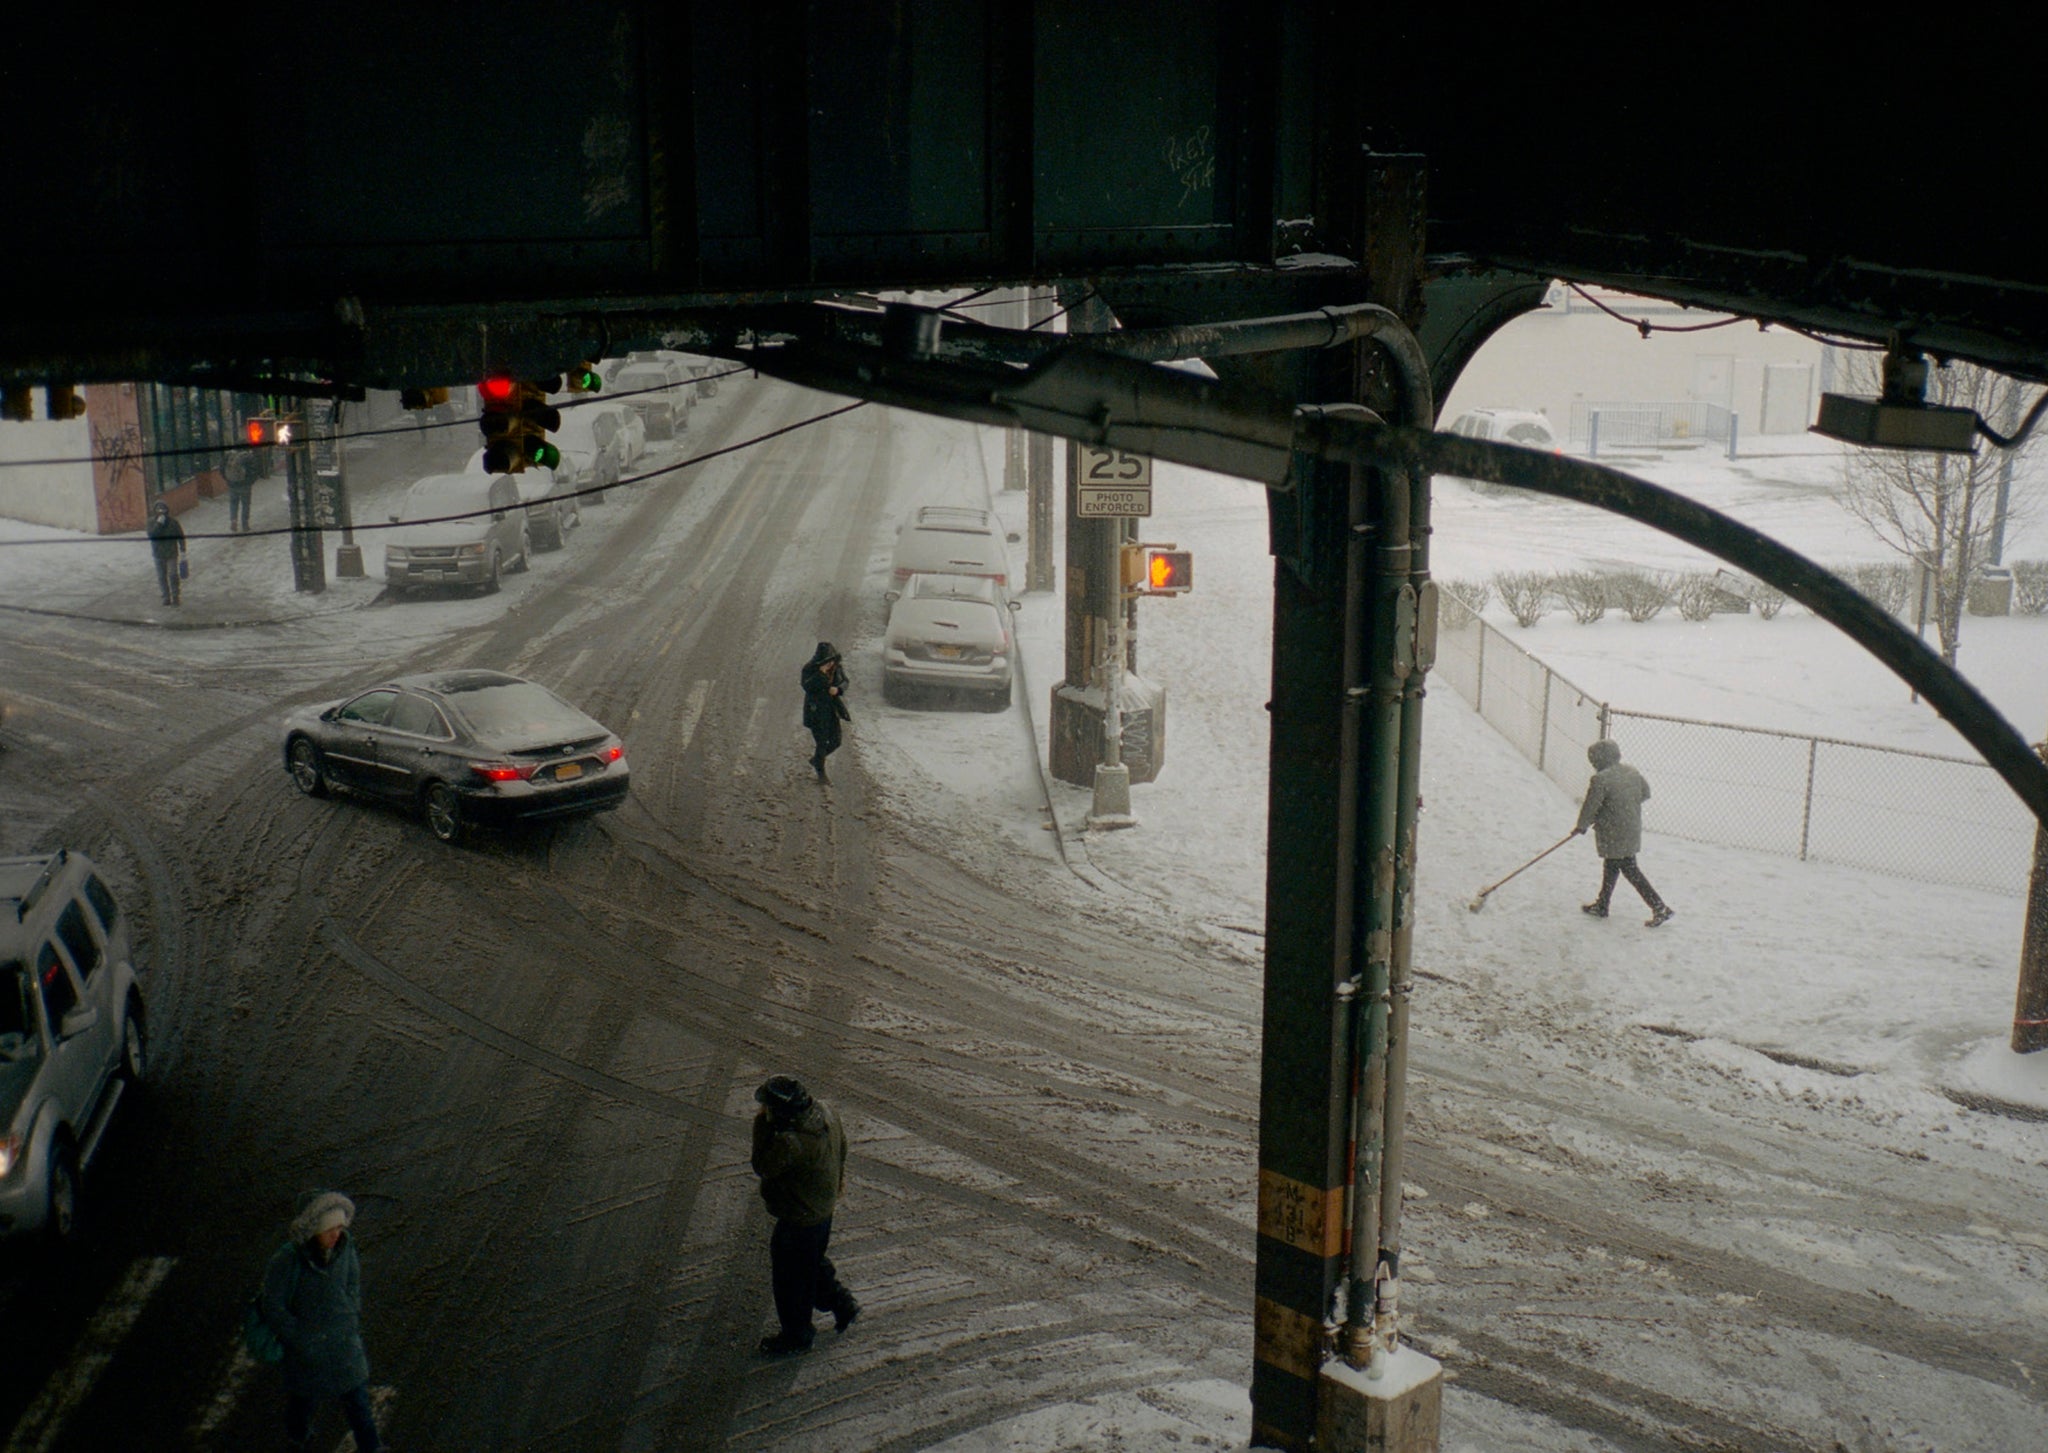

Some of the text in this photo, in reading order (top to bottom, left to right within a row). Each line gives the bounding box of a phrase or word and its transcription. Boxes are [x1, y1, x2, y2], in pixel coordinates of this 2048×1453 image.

[1089, 448, 1143, 479] 25
[1096, 493, 1134, 502] PHOTO
[1085, 503, 1145, 512] ENFORCED
